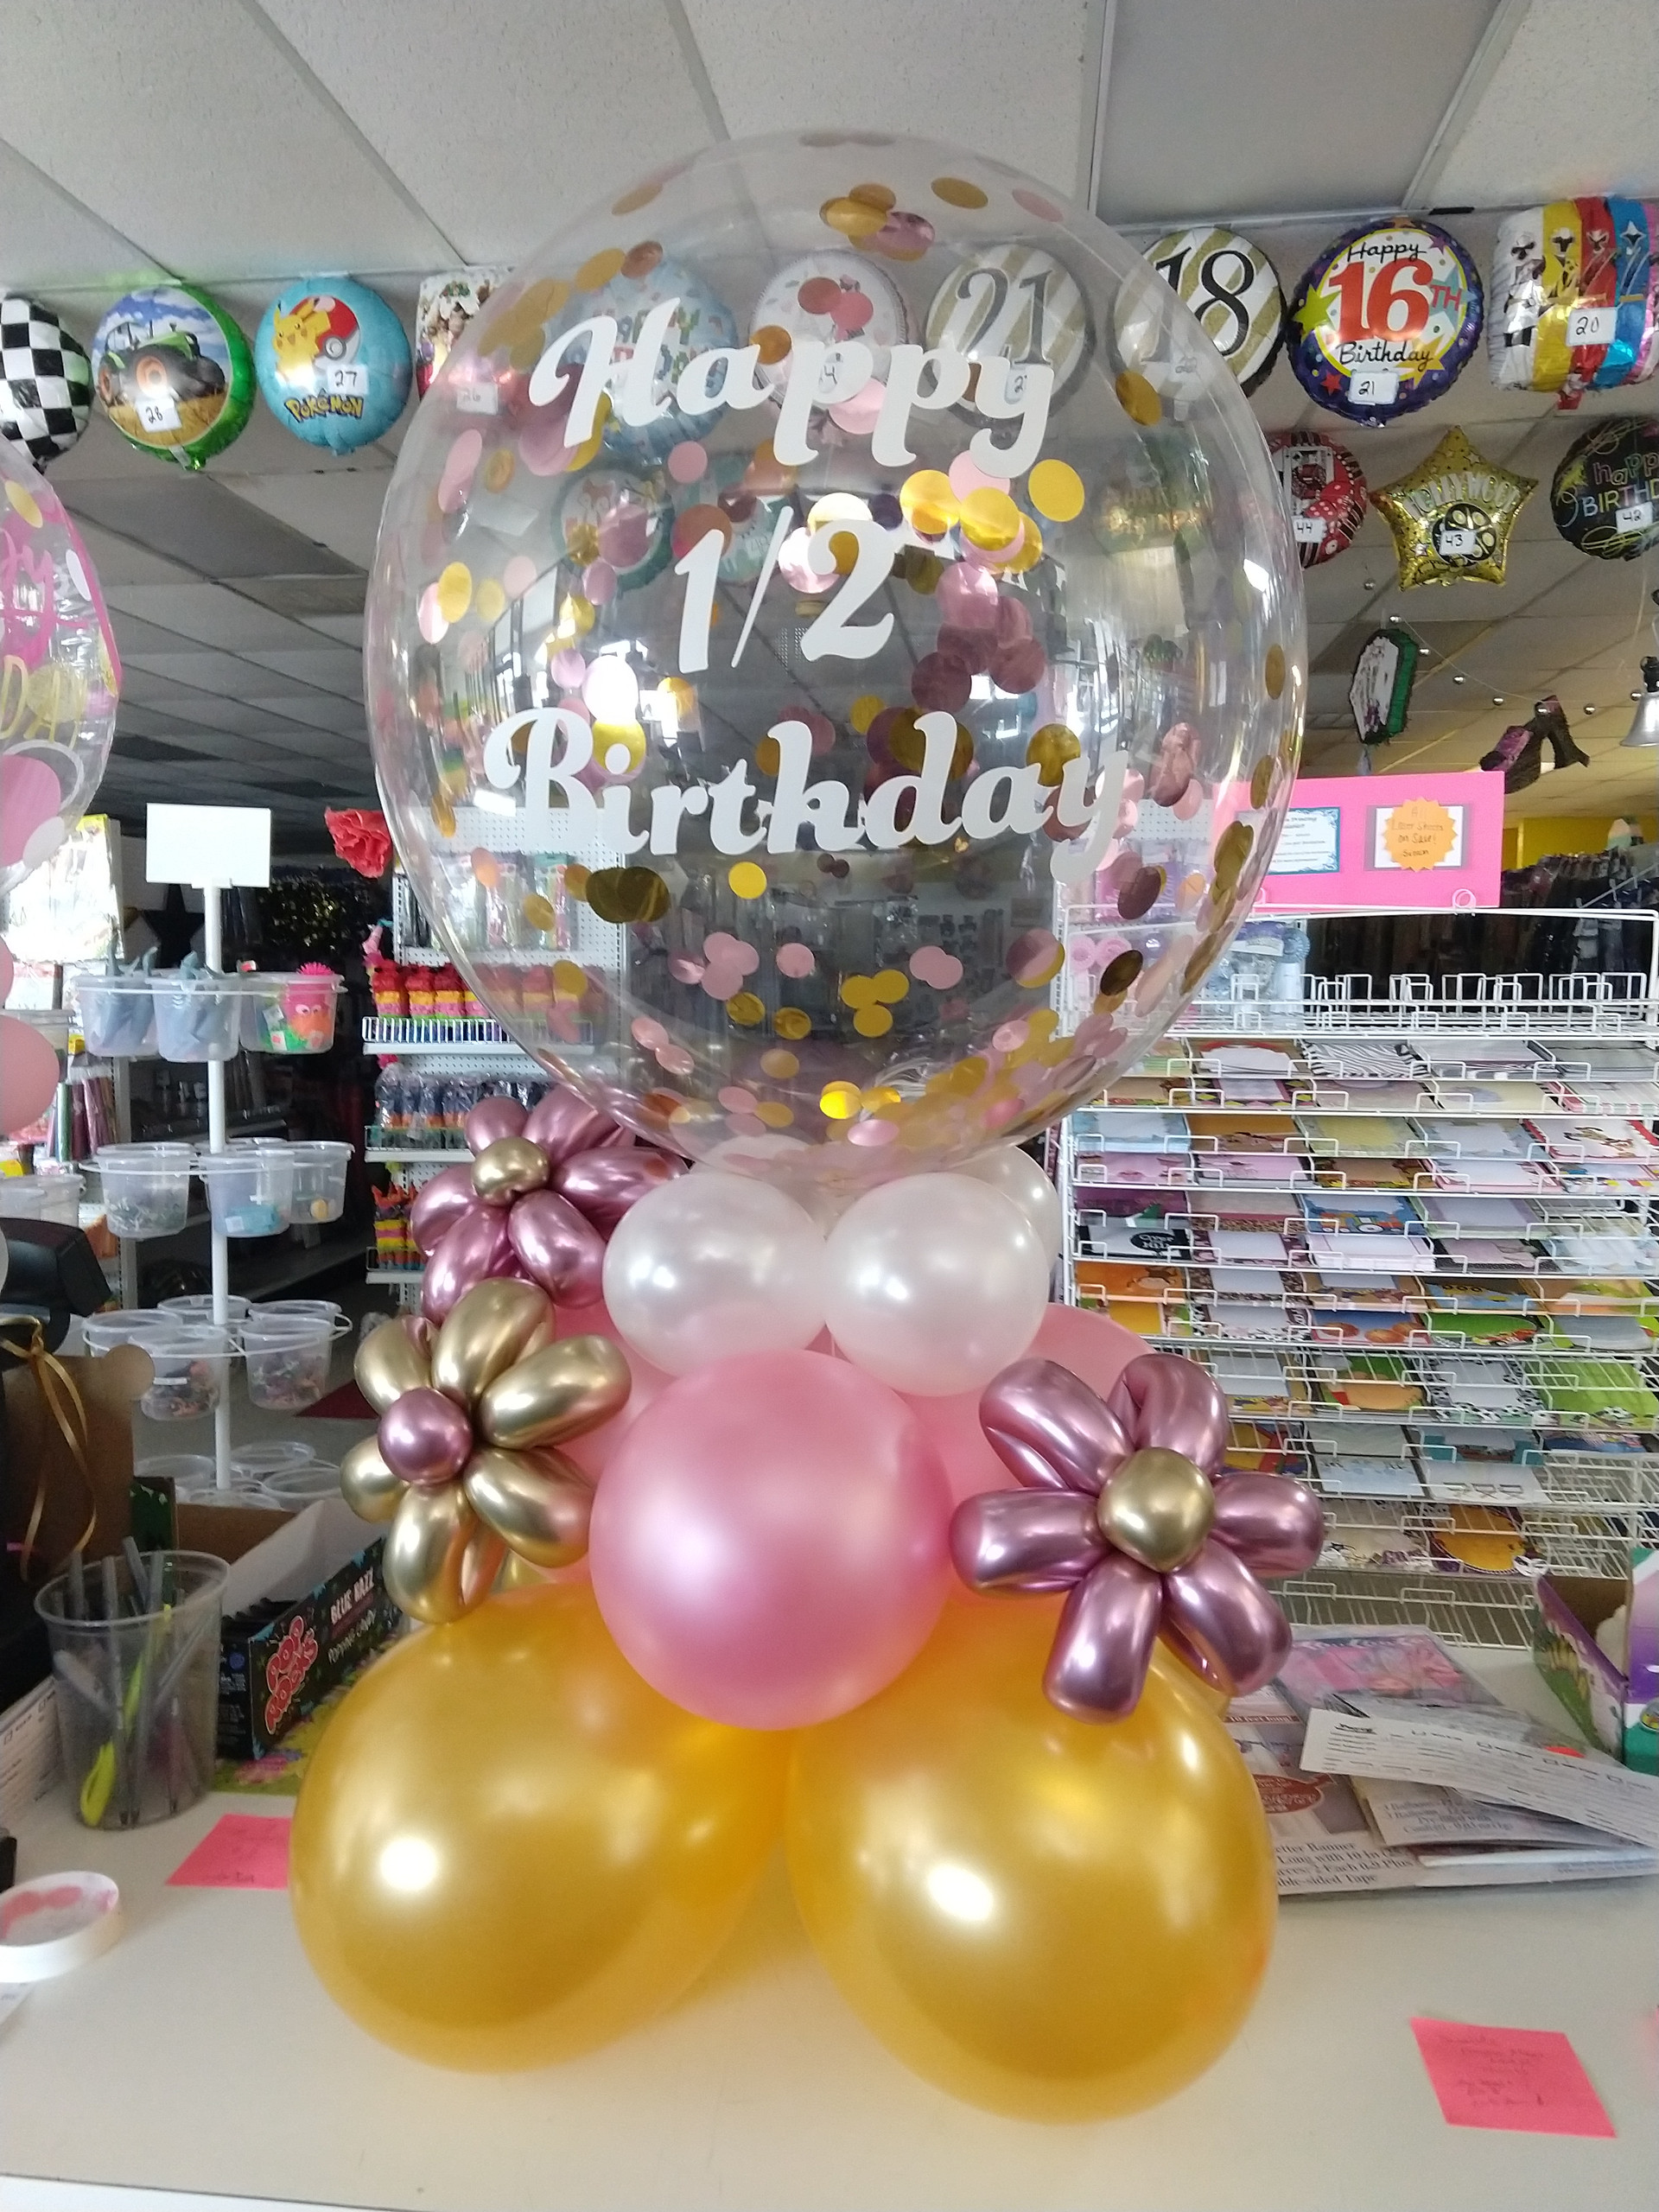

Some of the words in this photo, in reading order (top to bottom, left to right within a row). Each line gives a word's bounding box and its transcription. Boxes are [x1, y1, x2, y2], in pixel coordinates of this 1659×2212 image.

[1347, 242, 1427, 263] Happy
[957, 269, 1052, 365] 21
[1575, 316, 1599, 335] 20
[1336, 341, 1433, 372] Birthday
[334, 370, 357, 387] 27
[529, 297, 1054, 478] Happy
[1358, 381, 1375, 395] 21
[145, 407, 164, 423] 28
[1296, 522, 1313, 534] 44
[1444, 533, 1463, 546] 43
[674, 505, 895, 674] 1/2
[483, 707, 1128, 883] Birthday
[330, 1588, 353, 1624] BLUE
[1306, 1842, 1356, 1853] Banner
[1313, 1853, 1344, 1863] with
[1382, 1859, 1414, 1869] Plus
[1344, 1873, 1378, 1885] Tape
